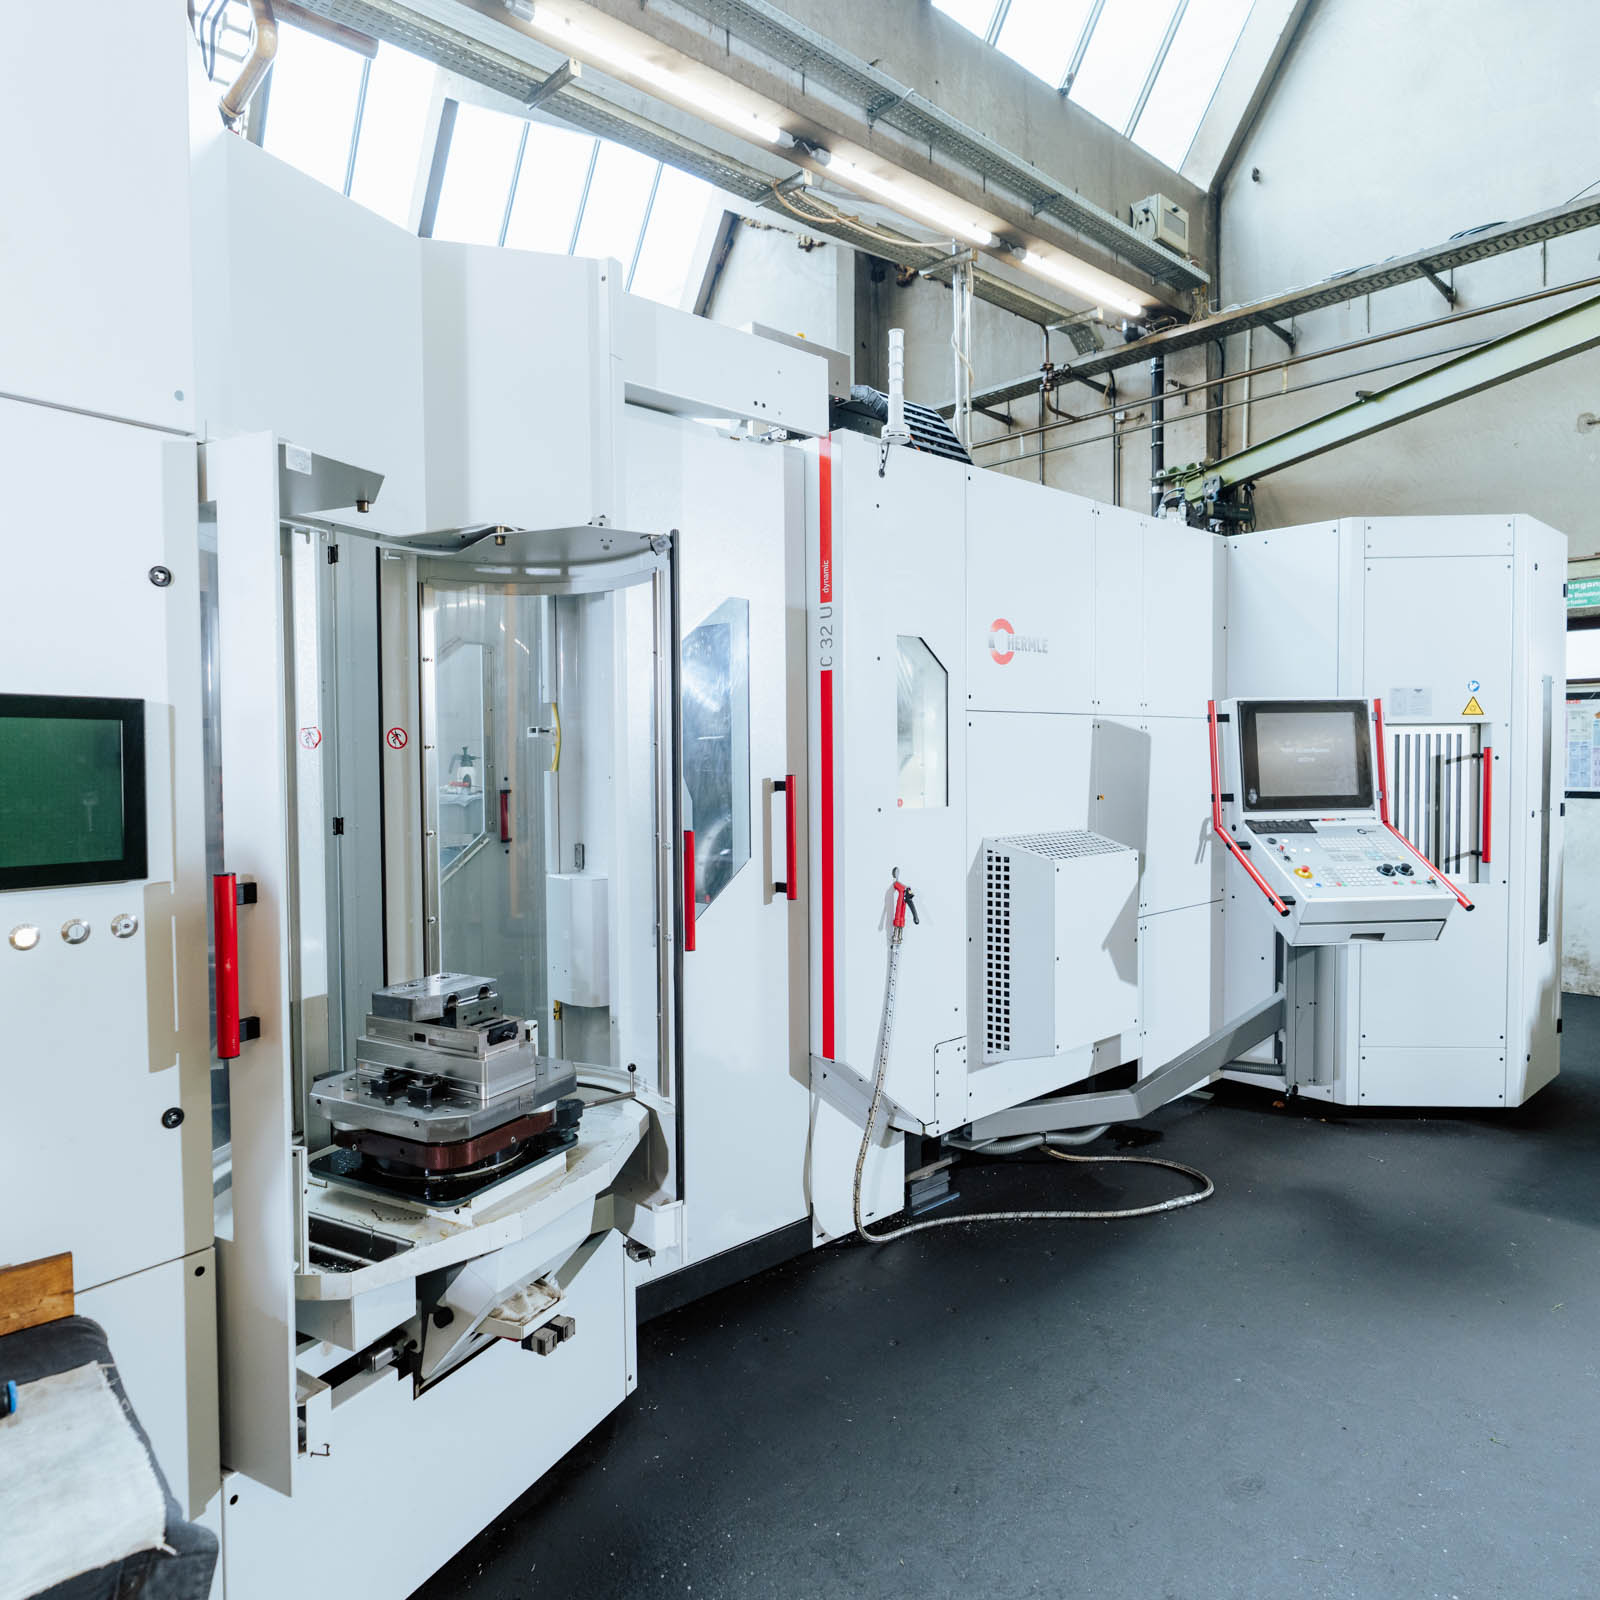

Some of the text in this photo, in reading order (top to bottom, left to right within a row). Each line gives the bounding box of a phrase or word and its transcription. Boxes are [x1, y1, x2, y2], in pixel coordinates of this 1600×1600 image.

[822, 560, 830, 593] dynamic
[819, 606, 833, 667] C 32 U
[1008, 635, 1049, 654] HERMLE
